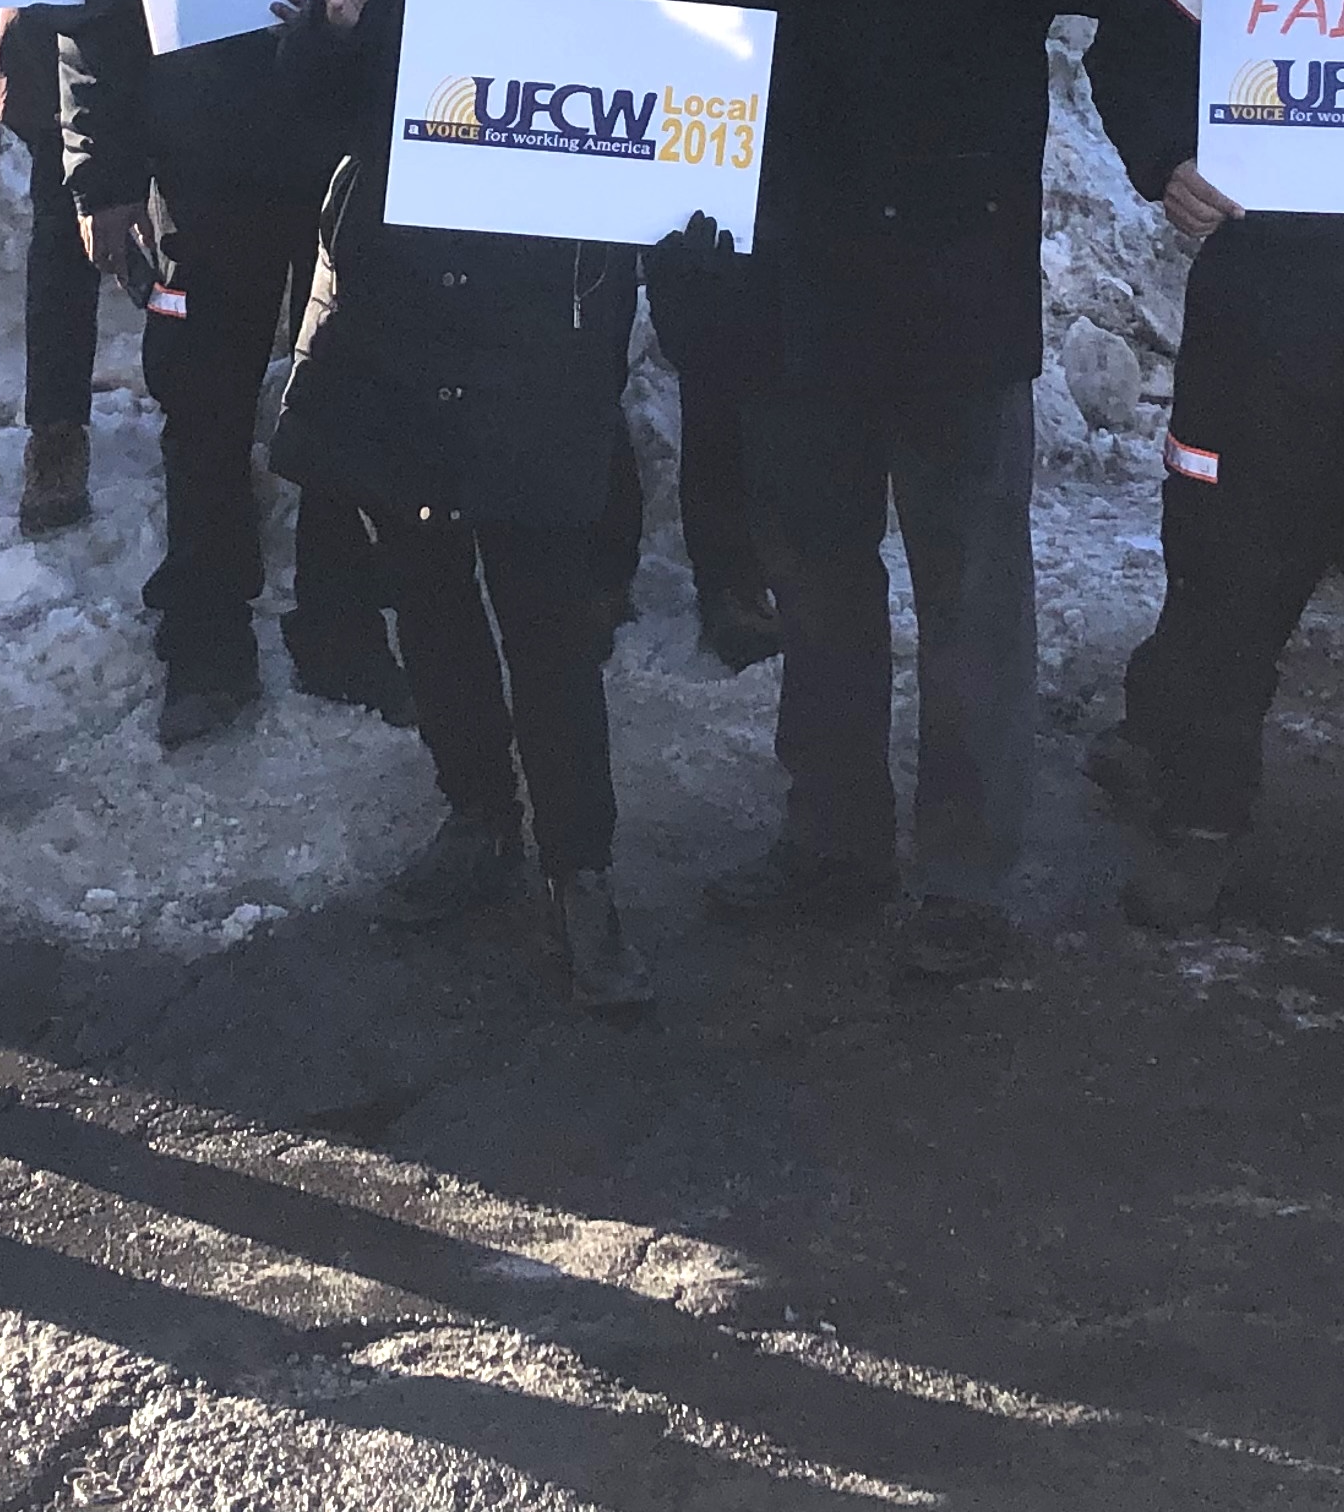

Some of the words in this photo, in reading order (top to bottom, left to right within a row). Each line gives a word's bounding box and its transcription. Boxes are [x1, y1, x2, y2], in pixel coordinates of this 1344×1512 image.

[471, 76, 658, 138] UFCW
[663, 86, 758, 122] Local
[1214, 107, 1225, 119] a
[1229, 106, 1284, 120] VOICE
[1289, 108, 1312, 122] for
[408, 124, 419, 135] a
[425, 123, 480, 140] VOICE
[485, 127, 509, 143] for
[512, 132, 580, 152] working
[582, 138, 651, 156] America
[658, 118, 754, 169] 2013
